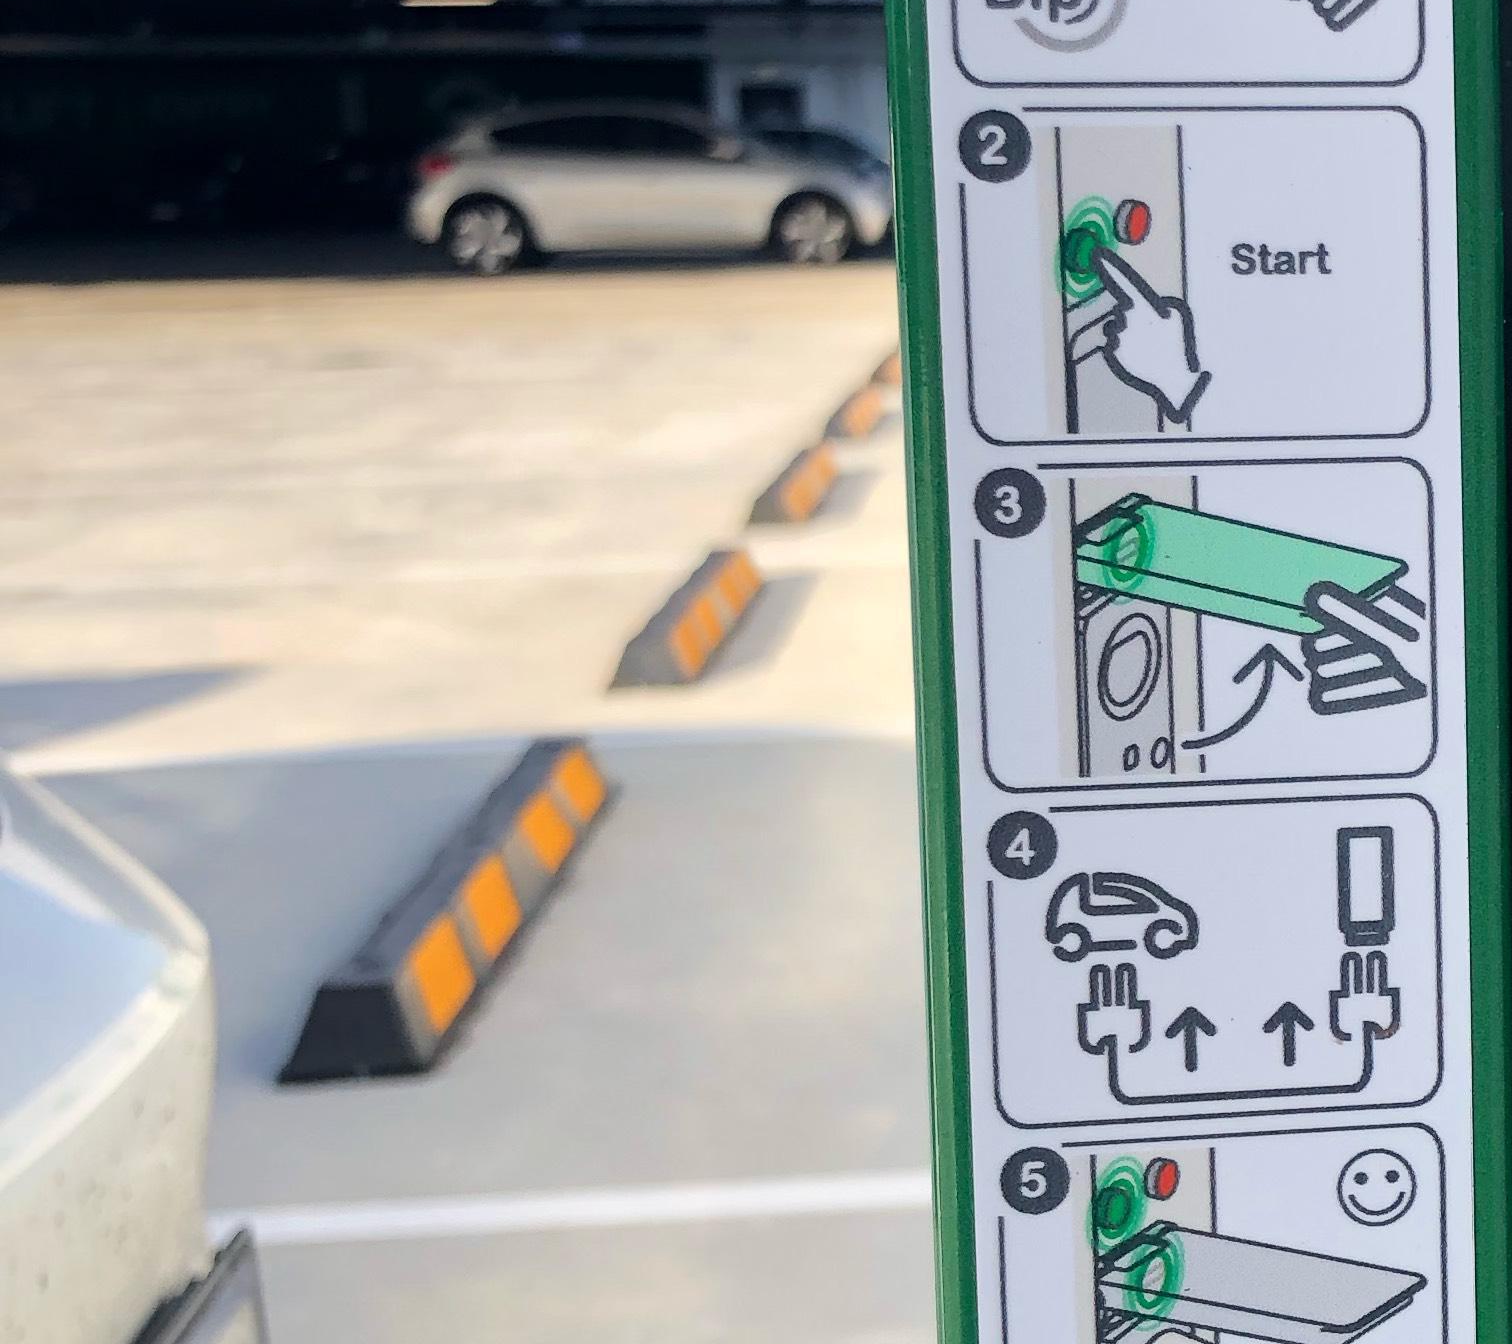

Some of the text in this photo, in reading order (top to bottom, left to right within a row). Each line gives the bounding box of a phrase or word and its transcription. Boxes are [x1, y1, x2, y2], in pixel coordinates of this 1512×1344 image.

[977, 124, 1008, 166] 2
[1230, 242, 1332, 276] Start
[993, 484, 1023, 525] 3
[1004, 827, 1036, 866] 4
[1019, 1160, 1047, 1199] 5
